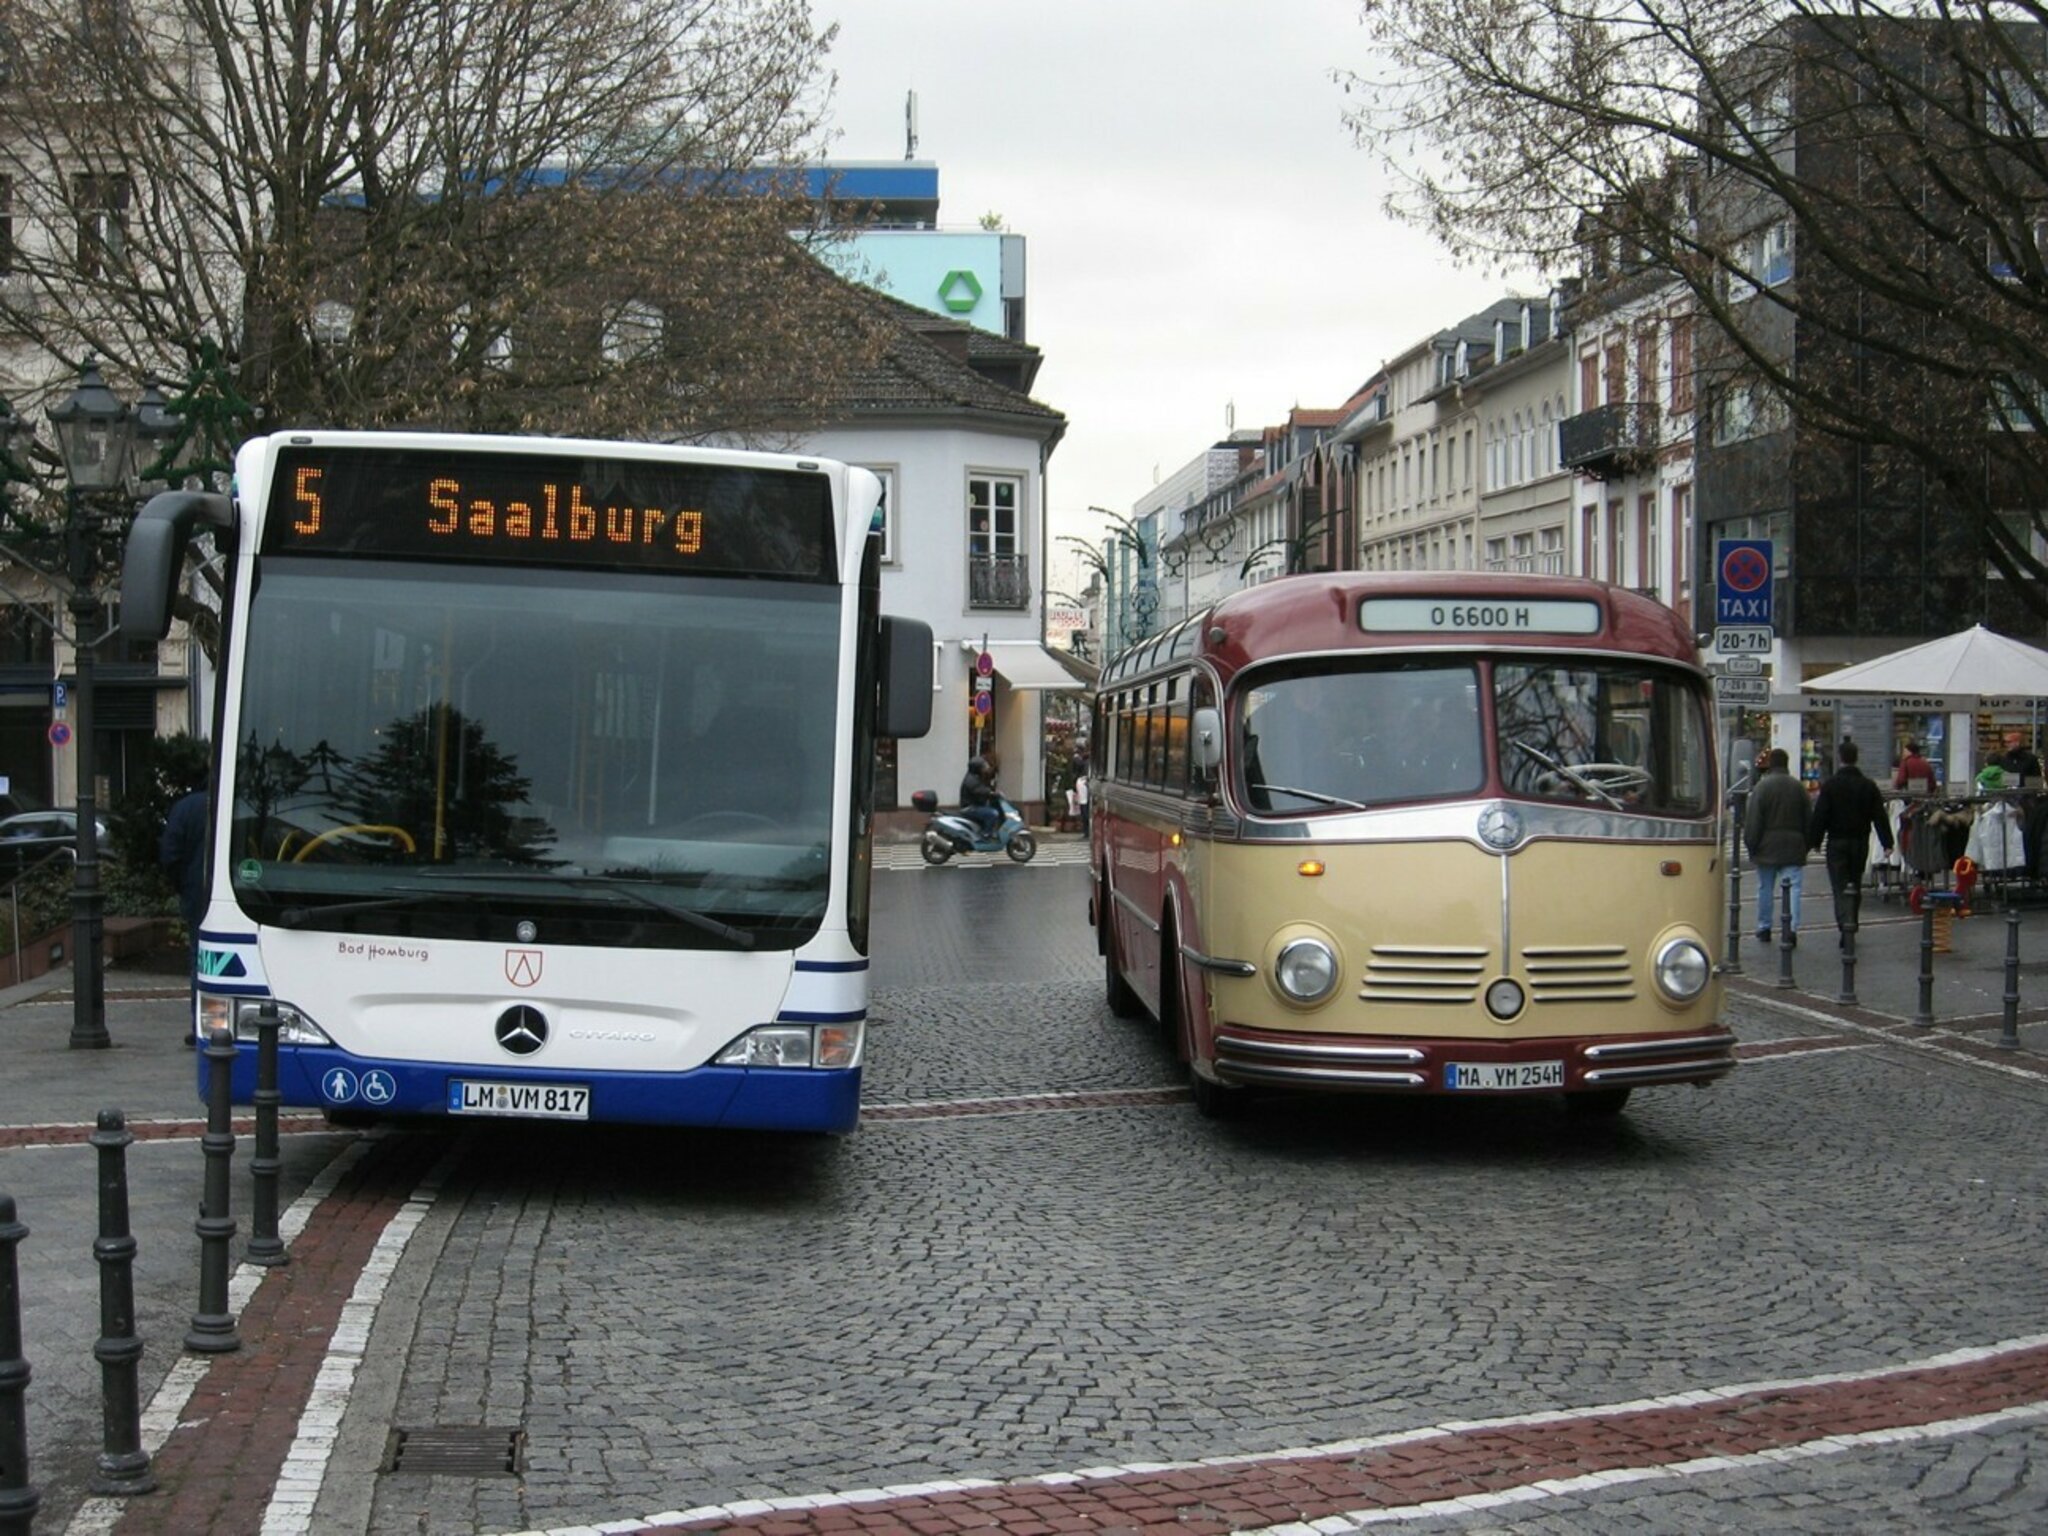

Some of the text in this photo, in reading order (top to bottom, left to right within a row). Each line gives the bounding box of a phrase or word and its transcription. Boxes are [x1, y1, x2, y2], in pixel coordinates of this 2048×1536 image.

[293, 467, 703, 553] 5 Saalburg
[1452, 606, 1509, 627] 6600
[1515, 607, 1530, 627] H
[1720, 598, 1768, 617] TAXI
[56, 685, 65, 704] P
[1810, 697, 1831, 707] ku
[1892, 698, 1945, 708] theke
[1979, 697, 2010, 707] kur
[339, 941, 429, 962] Bad Homburg
[568, 1028, 657, 1042] CITARO
[1458, 1064, 1563, 1086] MA YM 254H
[464, 1084, 587, 1112] LM VM 817
